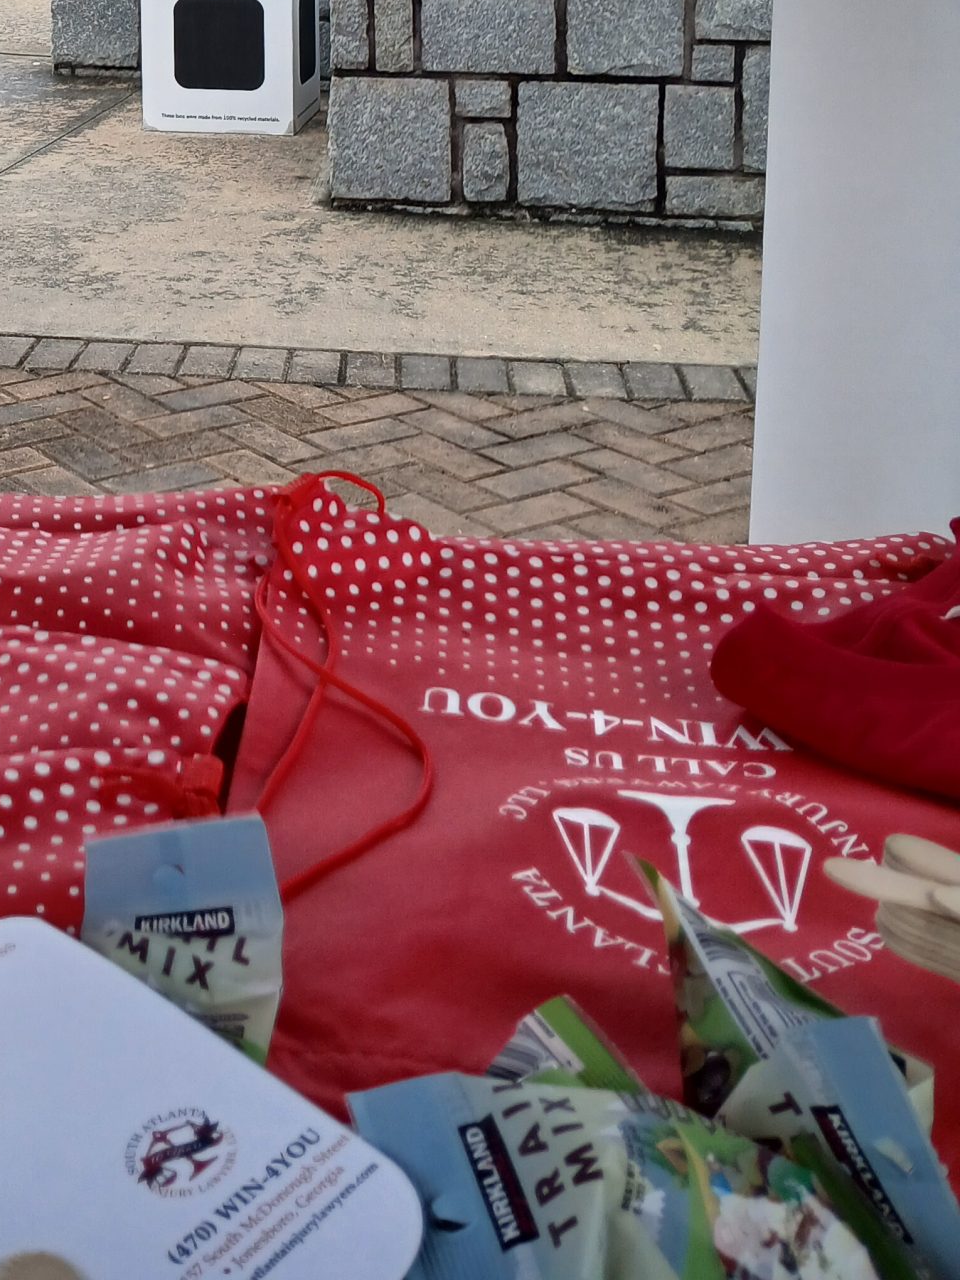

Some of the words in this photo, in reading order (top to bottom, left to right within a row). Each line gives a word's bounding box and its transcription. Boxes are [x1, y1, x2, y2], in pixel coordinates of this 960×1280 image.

[564, 746, 624, 771] US
[637, 753, 777, 779] CALL
[141, 910, 231, 933] KIRKLAND
[511, 866, 672, 976] LANTA
[116, 931, 215, 991] MIX
[782, 925, 886, 985] SOUT
[125, 1132, 143, 1176] SOUTH
[142, 1107, 208, 1133] ATLANTA
[539, 1096, 604, 1187] MIX
[168, 1221, 218, 1265] (470)
[214, 1127, 321, 1221] WIN-4YOU
[202, 1231, 243, 1264] South
[312, 1133, 350, 1164] Street
[295, 1165, 346, 1210] Georgia
[463, 1125, 523, 1248] KIRKLAND
